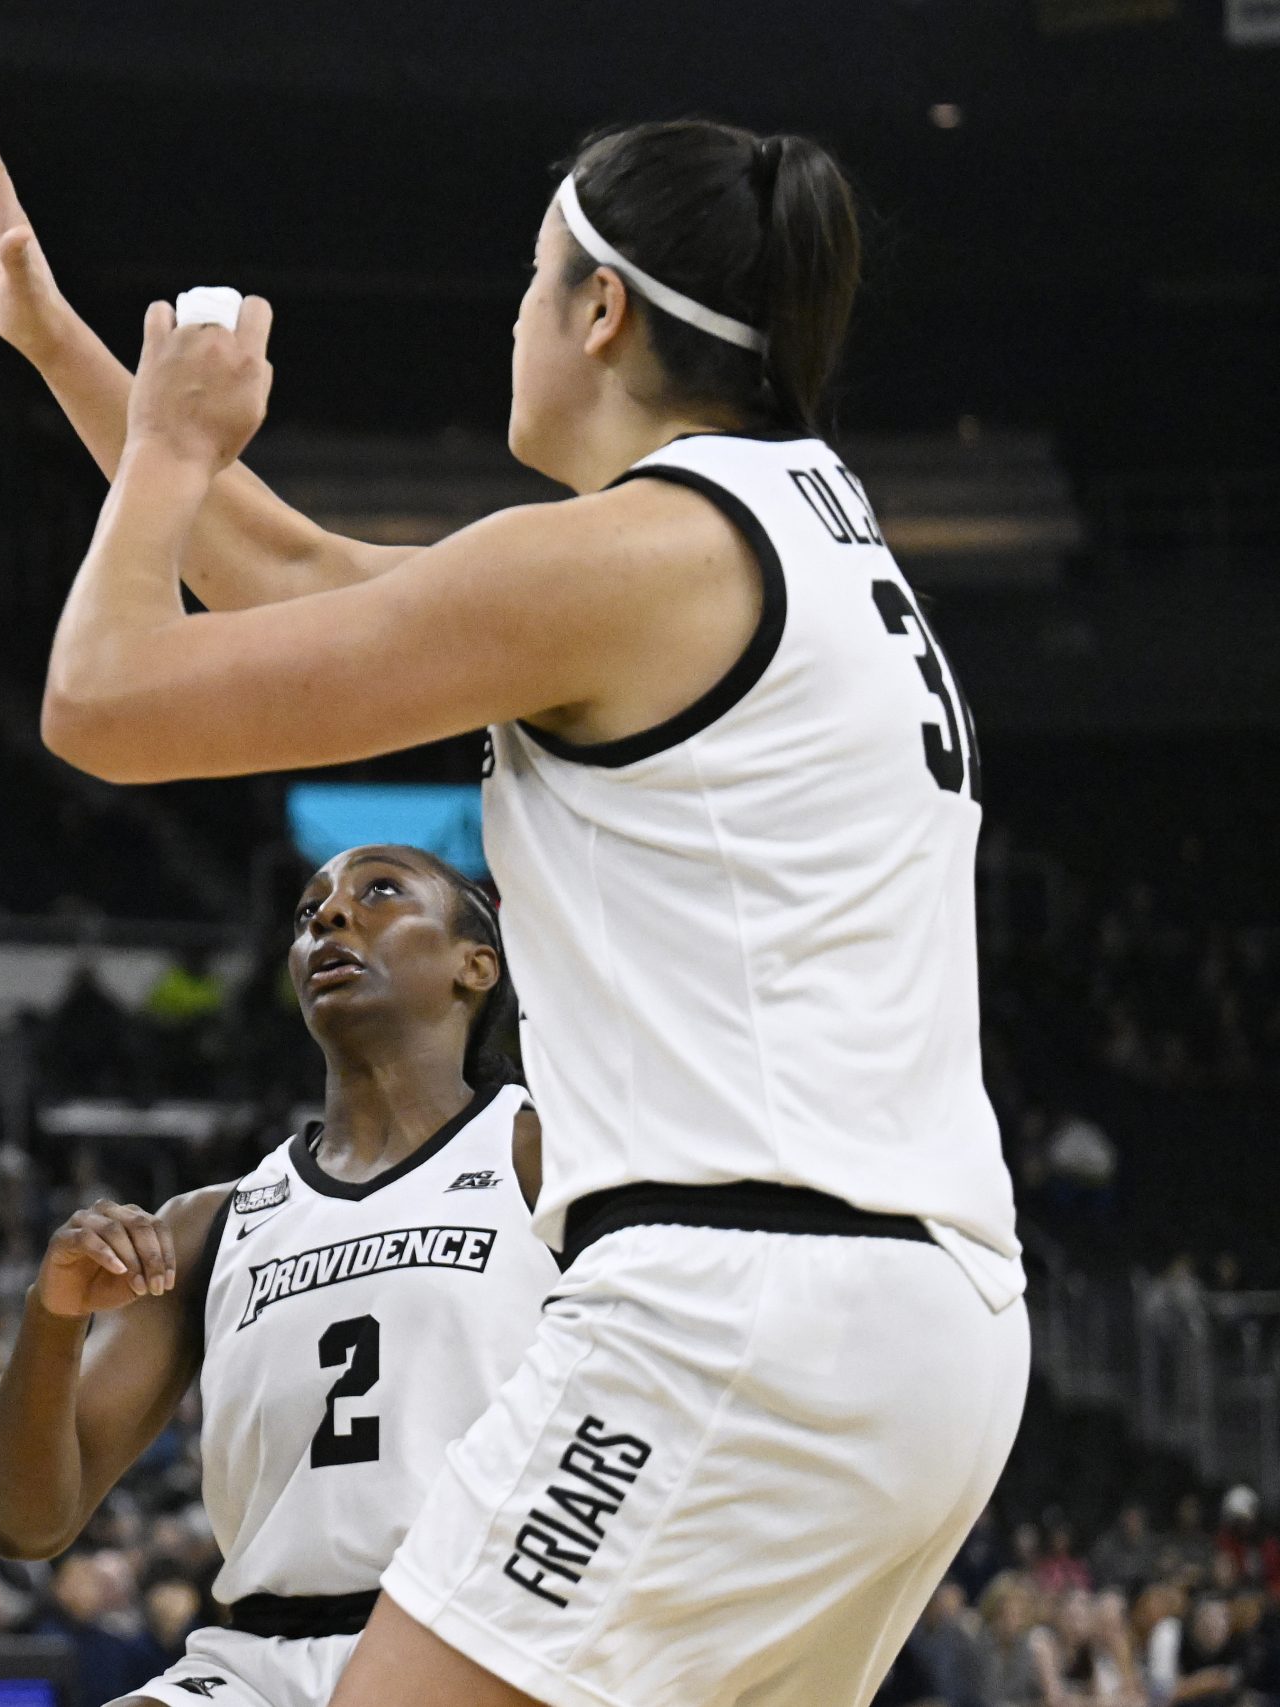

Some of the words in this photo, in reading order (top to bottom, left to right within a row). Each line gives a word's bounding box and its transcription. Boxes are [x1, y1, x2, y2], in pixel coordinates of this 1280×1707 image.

[447, 1178, 504, 1189] EAST
[236, 1225, 498, 1332] PROVIDENCE
[310, 1313, 380, 1470] 2
[503, 1414, 652, 1610] FRIARS
